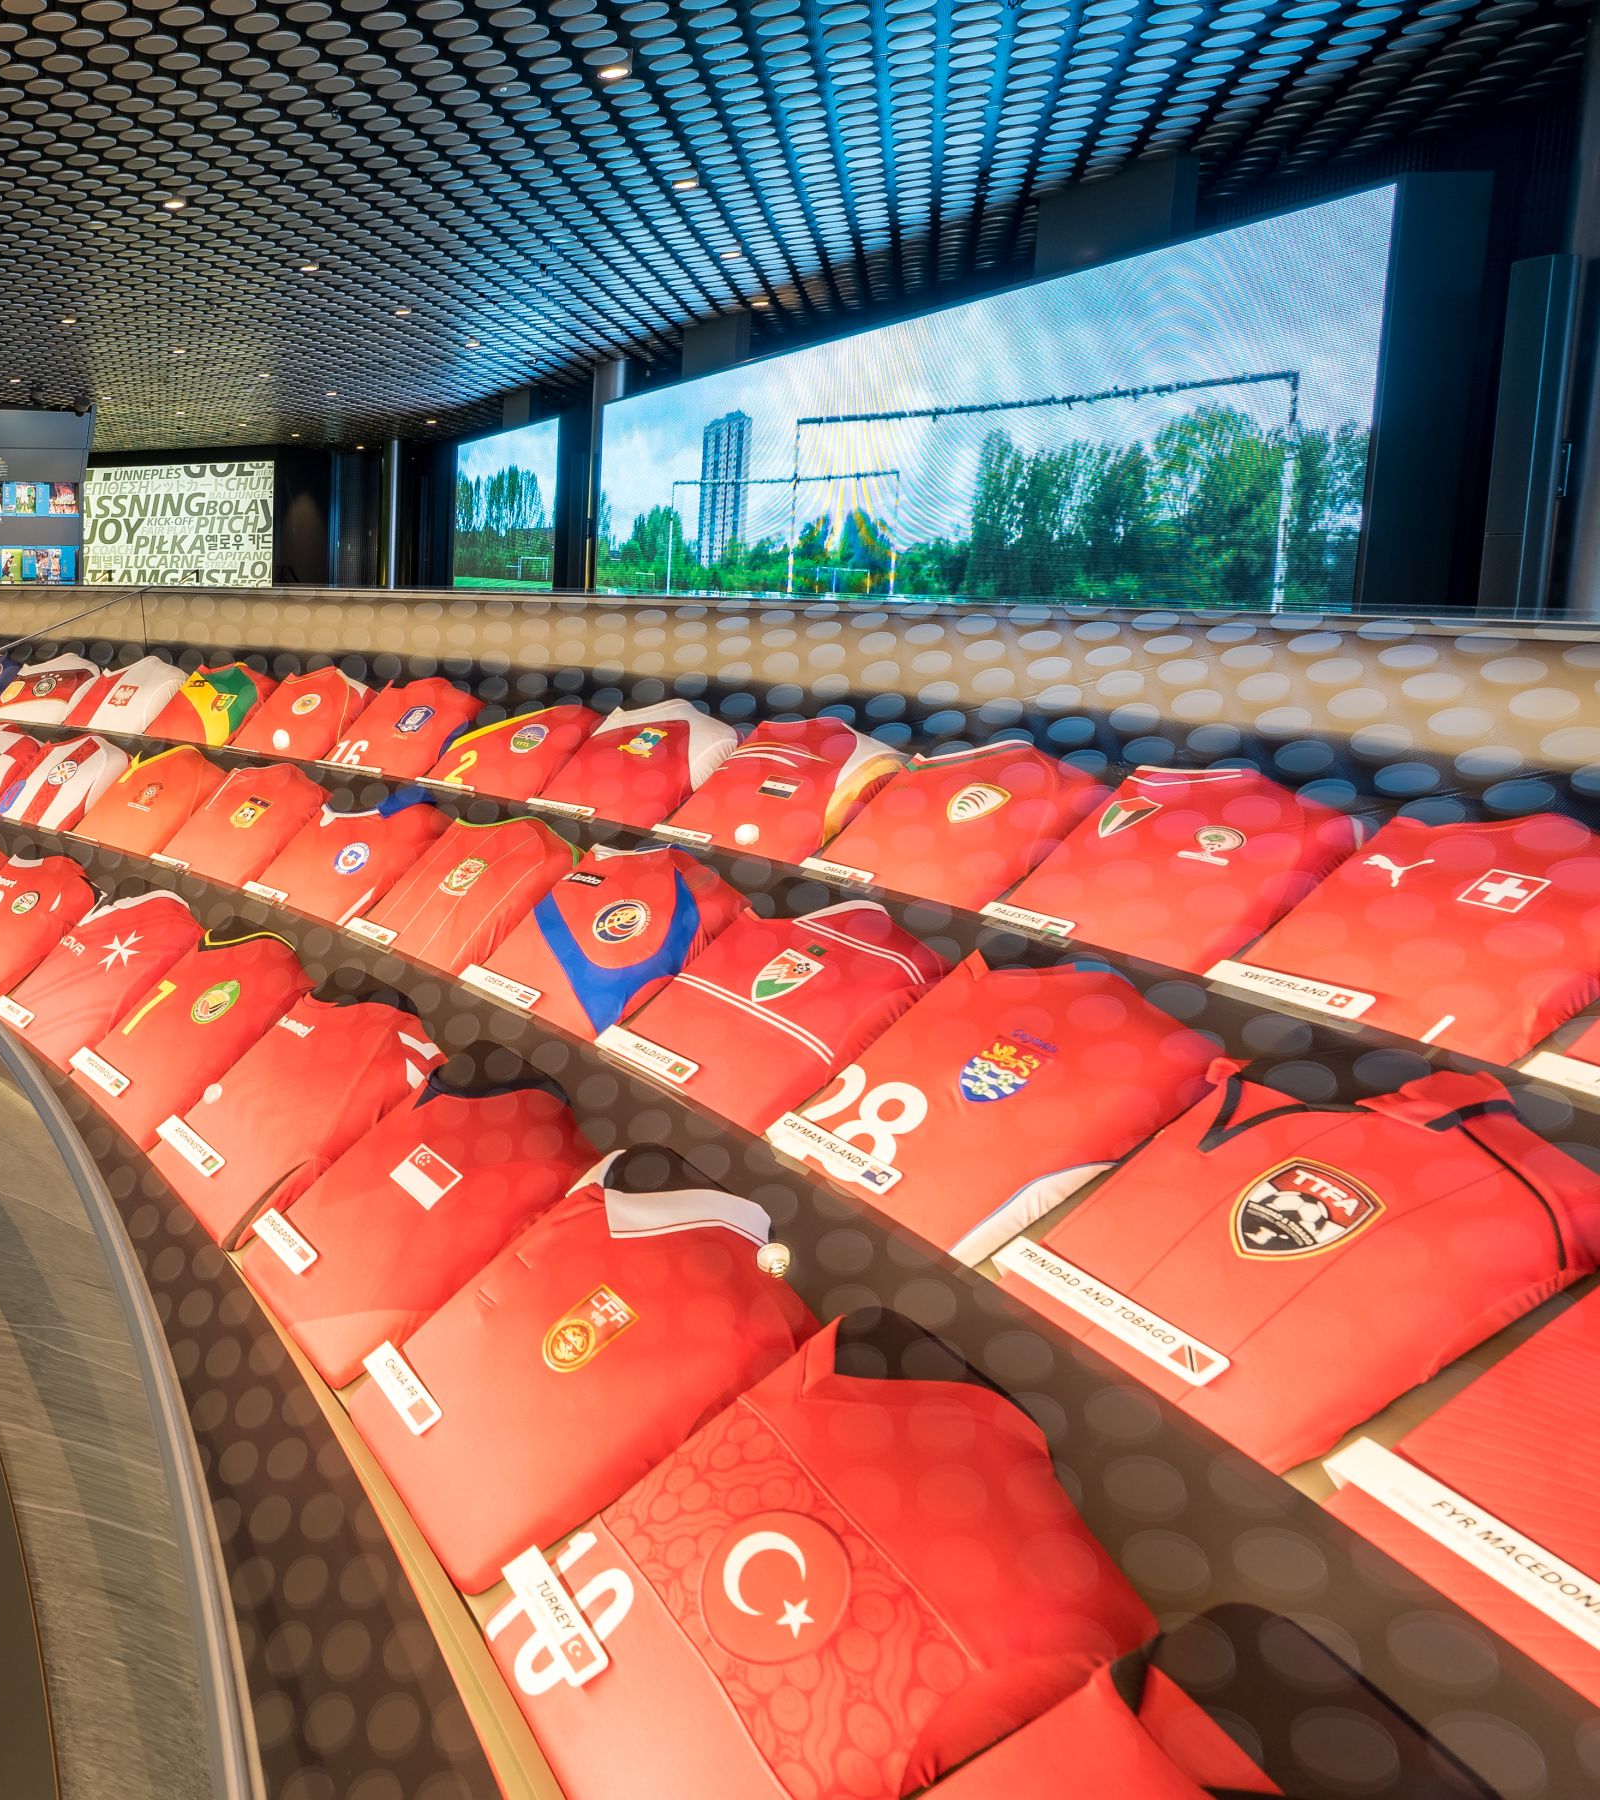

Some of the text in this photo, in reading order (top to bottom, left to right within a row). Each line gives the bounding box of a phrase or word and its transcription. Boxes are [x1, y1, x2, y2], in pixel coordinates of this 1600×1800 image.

[114, 466, 182, 480] ÜNNEPLÉS
[151, 478, 224, 492] レッドカード
[209, 490, 268, 500] BALLJUNGE
[205, 499, 260, 516] BOLA
[84, 518, 146, 544] JOY
[142, 526, 194, 535] FAIR PLAY
[147, 517, 194, 526] KICK-OFF
[195, 516, 260, 534] PITCH
[92, 545, 134, 555] COACH
[134, 535, 206, 554] PIŁKA
[205, 534, 244, 550] 옐로우
[92, 556, 123, 569] 페널티
[125, 554, 206, 569] LUCARNE
[207, 551, 272, 561] CAPITANO
[330, 740, 369, 765] 16
[444, 750, 478, 784] 2
[572, 874, 602, 886] lotto
[824, 865, 848, 876] OMAN
[993, 906, 1042, 925] PALESTINE
[485, 975, 520, 994] COSTA RICA
[1240, 970, 1330, 998] SWITZERLAND
[633, 1042, 672, 1064] MALDIVES
[175, 1126, 208, 1157] AFGHANISTAN
[784, 1118, 868, 1168] CAYMAN ISLANDS
[1293, 1169, 1359, 1216] TTFA
[264, 1215, 298, 1249] SINGAPORE
[1019, 1248, 1176, 1345] TRINIDAD AND TOBAGO
[385, 1358, 418, 1399] CHINA PR
[1432, 1500, 1477, 1528] FYR
[536, 1580, 575, 1630] TURKEY
